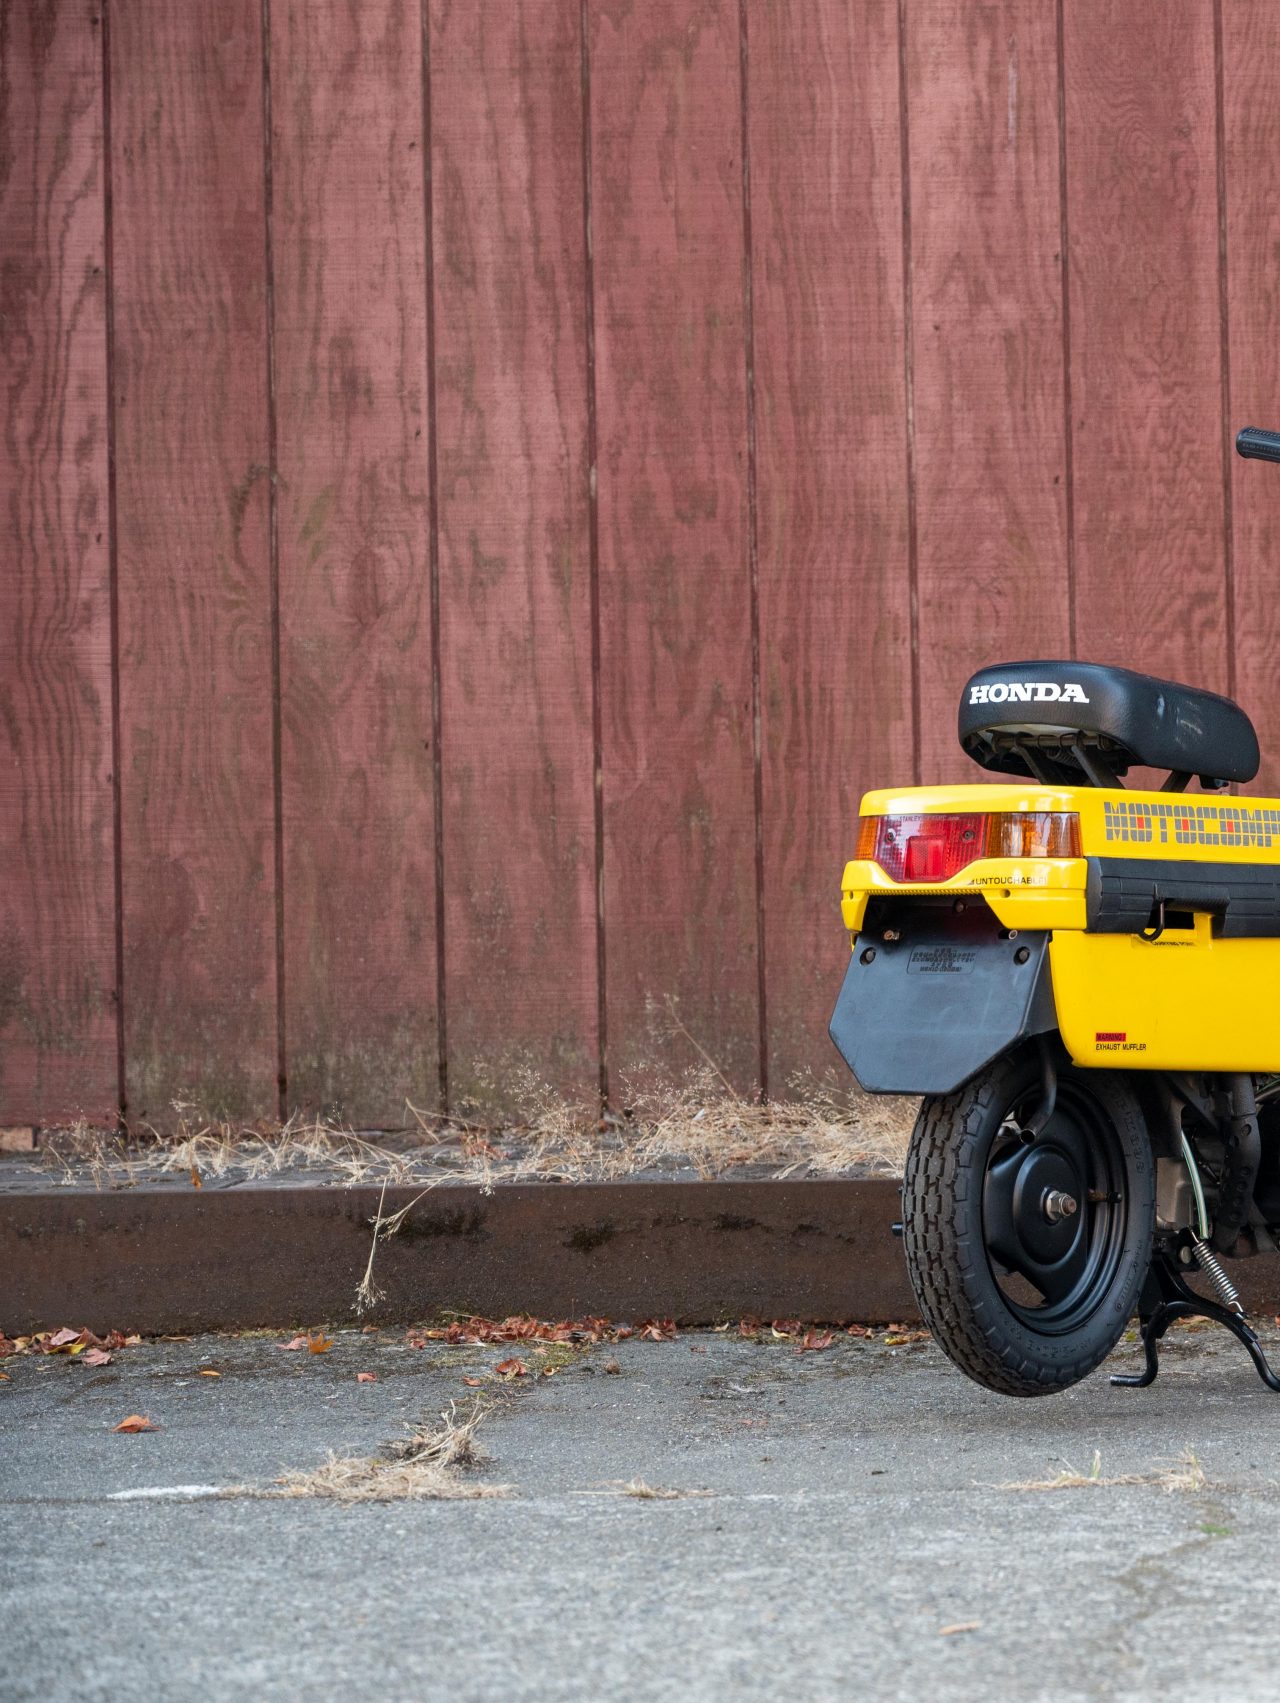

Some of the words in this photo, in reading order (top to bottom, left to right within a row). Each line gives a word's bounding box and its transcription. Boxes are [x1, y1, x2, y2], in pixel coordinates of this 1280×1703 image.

[969, 682, 1090, 705] HONDA
[1096, 1043, 1121, 1051] EXHAUST
[1122, 1043, 1147, 1051] MUFFLER
